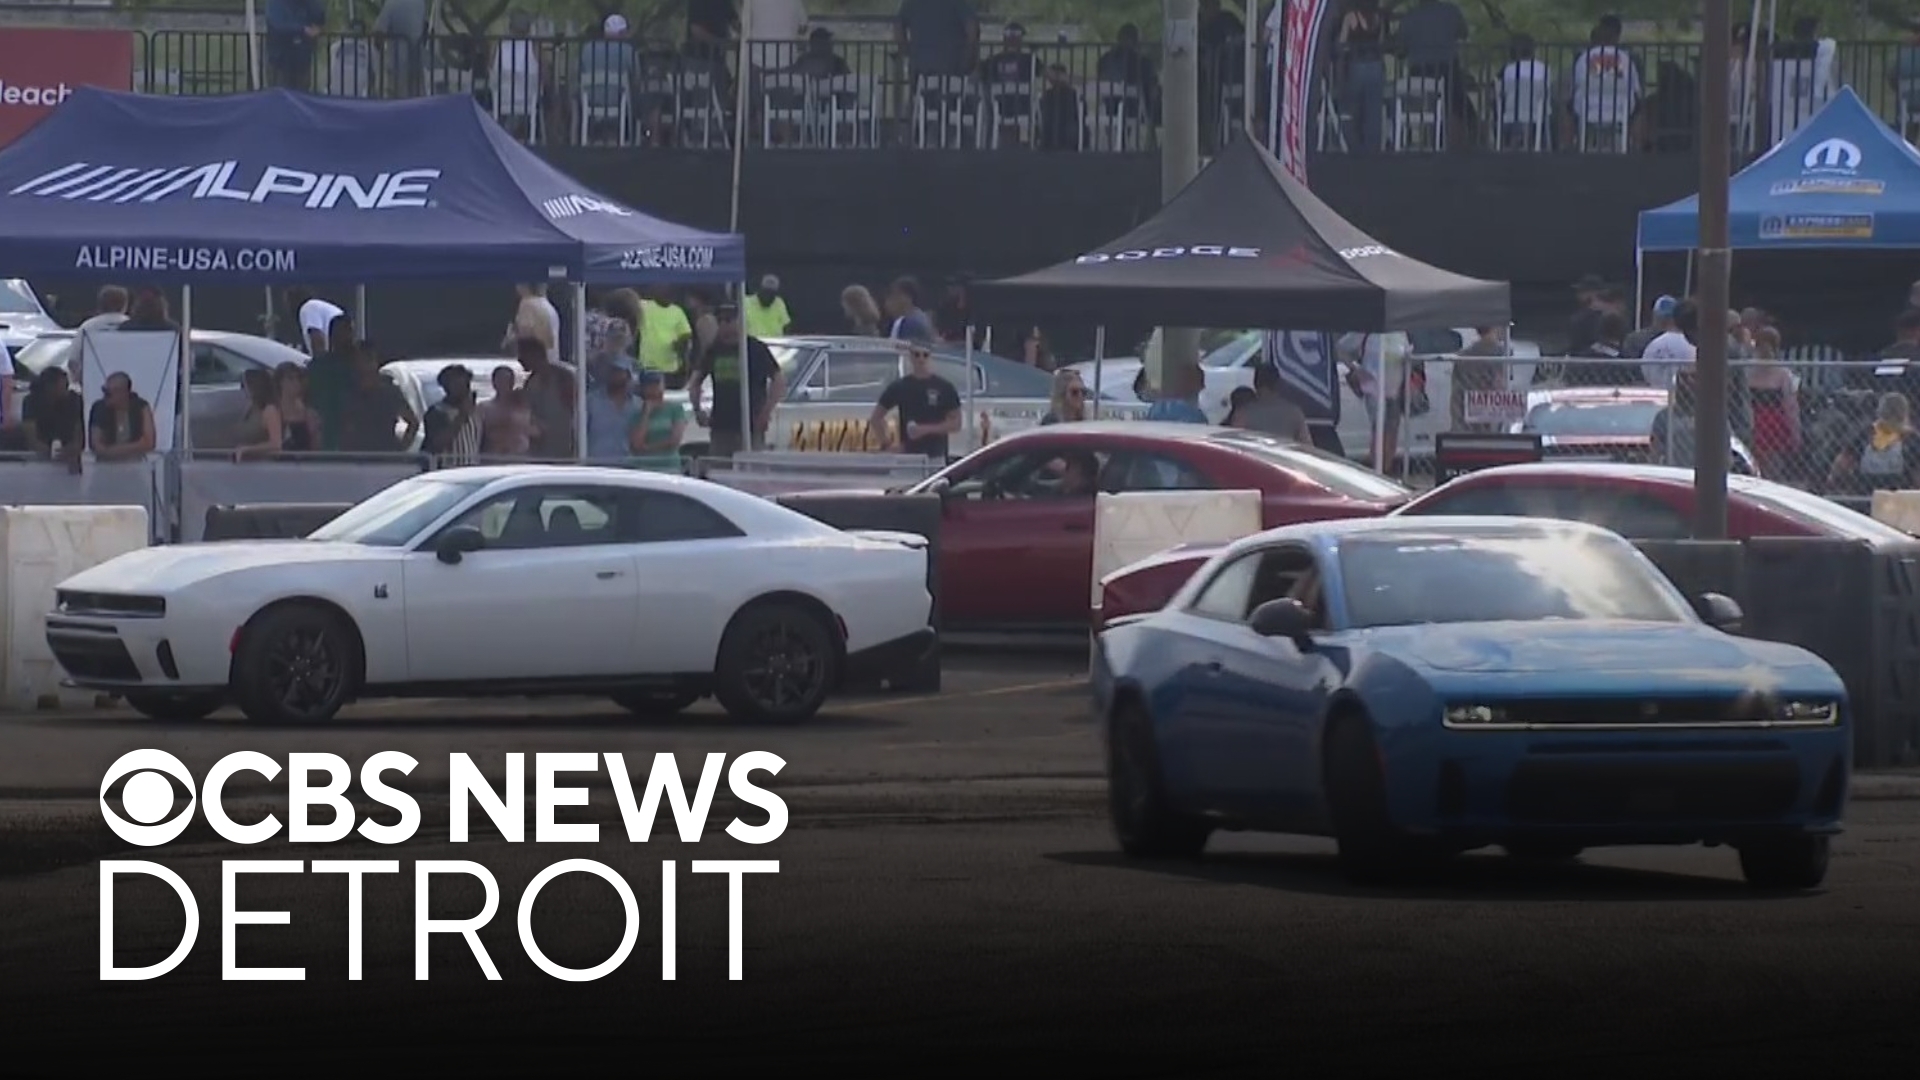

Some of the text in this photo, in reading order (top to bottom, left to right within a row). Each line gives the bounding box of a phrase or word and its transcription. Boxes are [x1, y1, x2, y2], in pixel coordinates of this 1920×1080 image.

[145, 161, 441, 208] ALPINE
[76, 246, 296, 271] ALPINE-USA.COM
[1076, 245, 1261, 265] DODGE
[1469, 390, 1525, 408] NATIONAL
